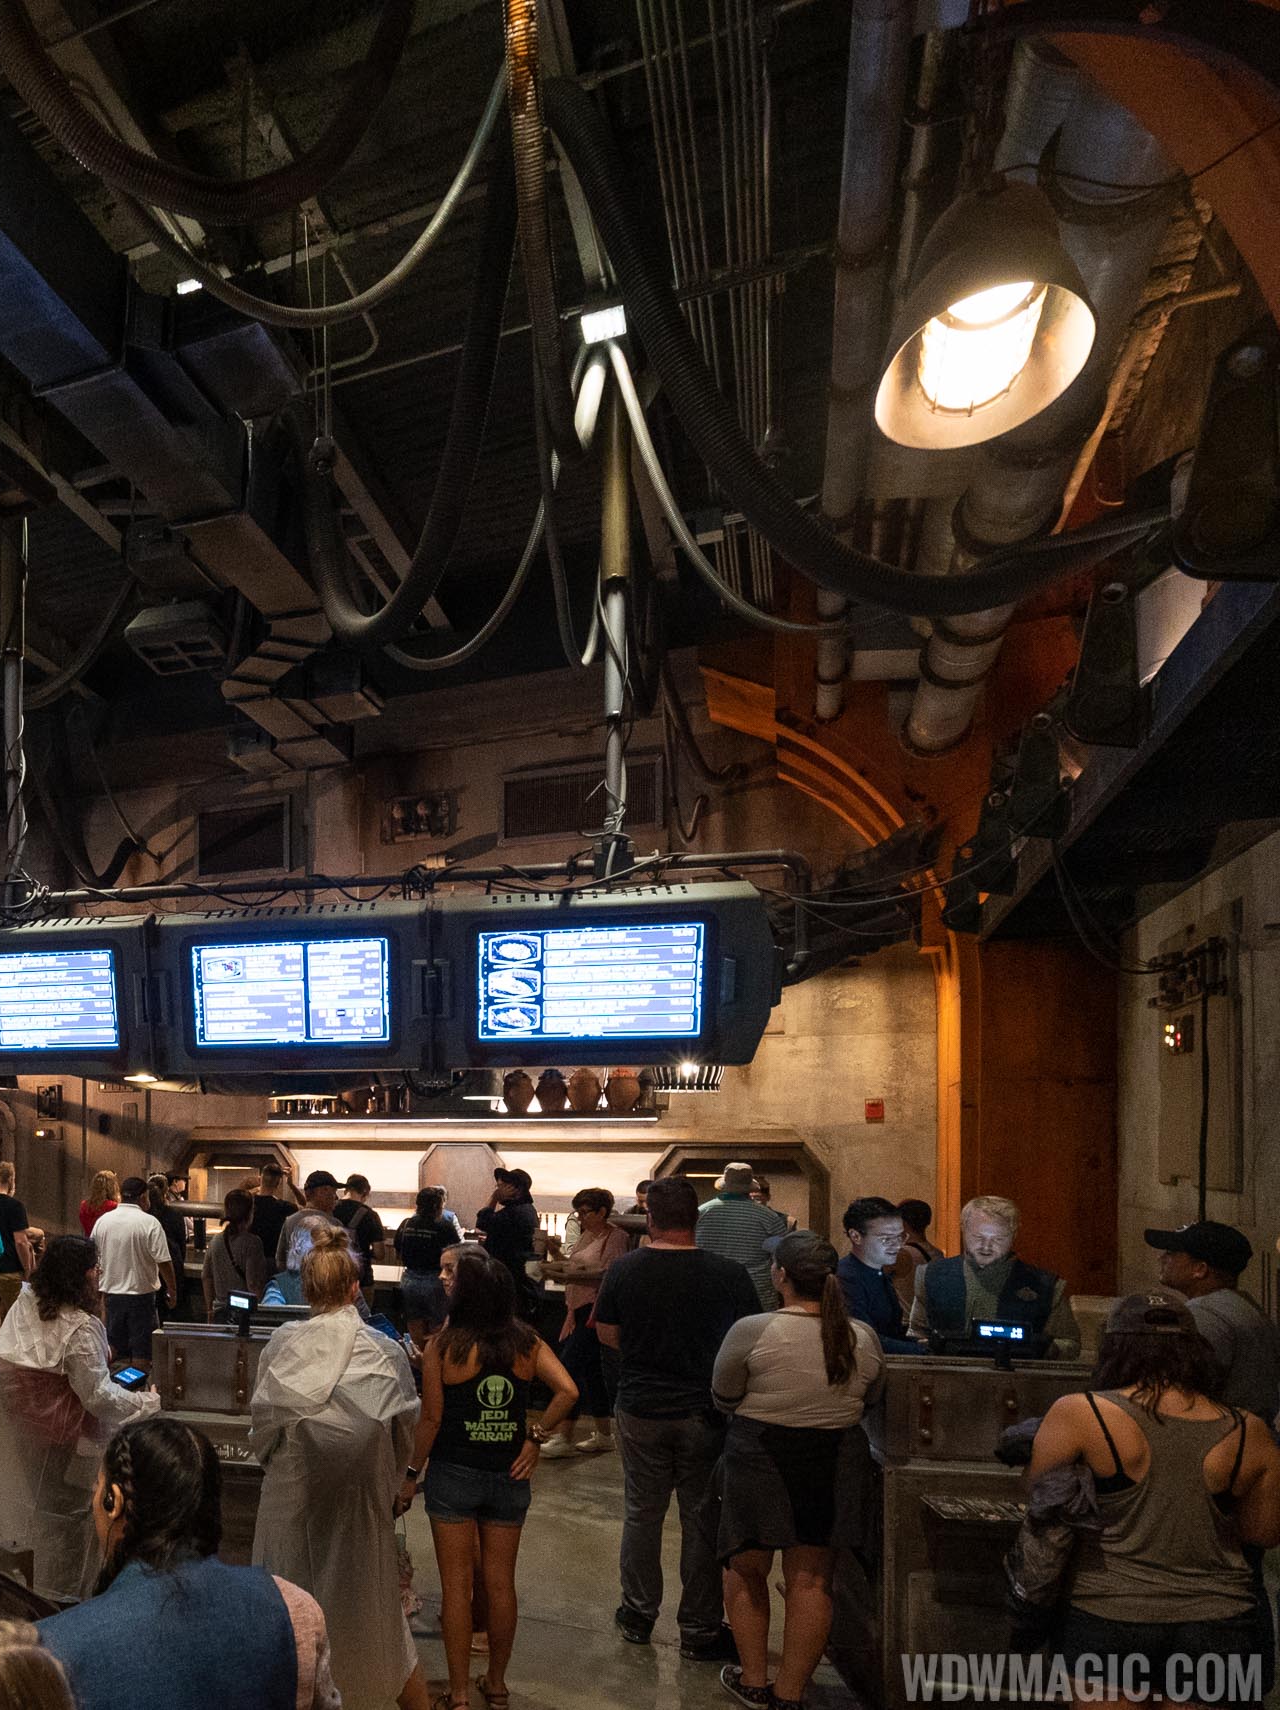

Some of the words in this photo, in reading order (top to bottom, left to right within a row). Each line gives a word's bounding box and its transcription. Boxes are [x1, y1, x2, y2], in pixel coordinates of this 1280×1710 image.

[479, 1409, 509, 1422] JEDI
[464, 1421, 518, 1431] MASTER
[469, 1431, 513, 1442] SARAH
